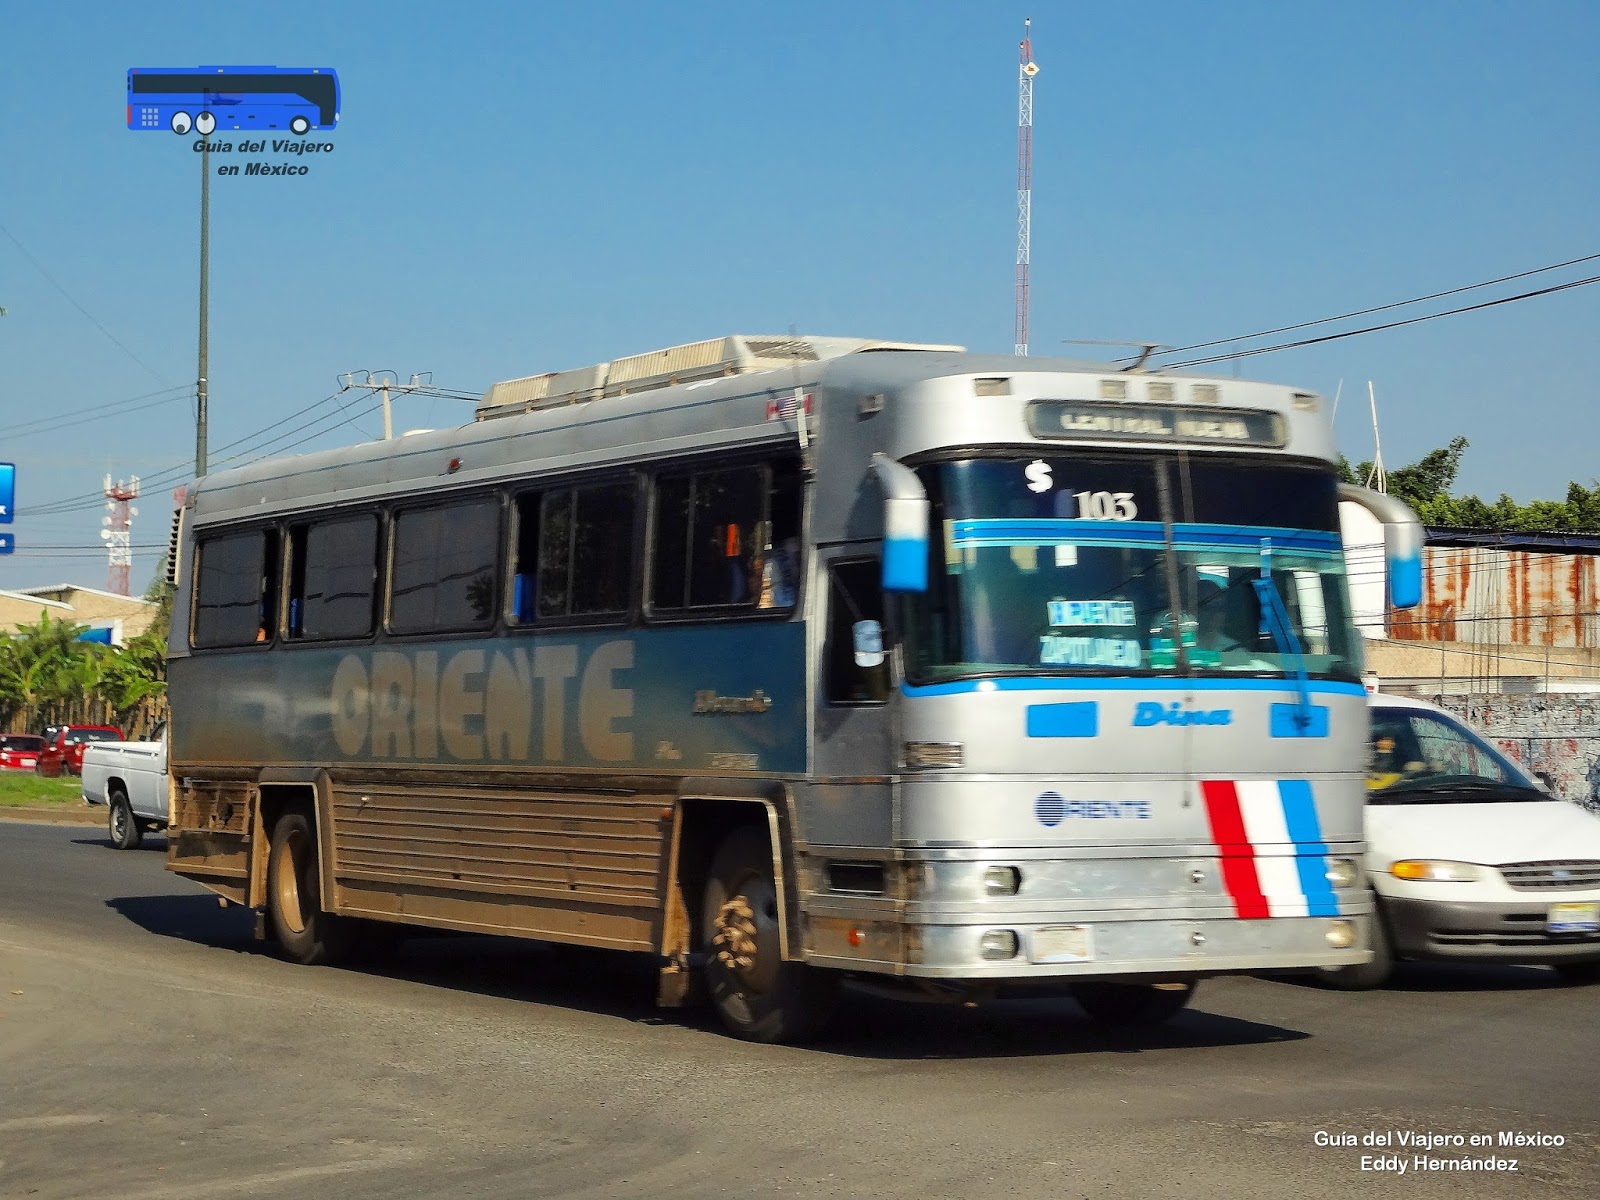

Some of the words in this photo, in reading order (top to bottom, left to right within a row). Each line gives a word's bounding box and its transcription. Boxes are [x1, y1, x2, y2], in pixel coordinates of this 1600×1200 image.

[1072, 490, 1138, 521] 103
[333, 639, 634, 762] ORIENTE
[1132, 701, 1233, 727] Dina
